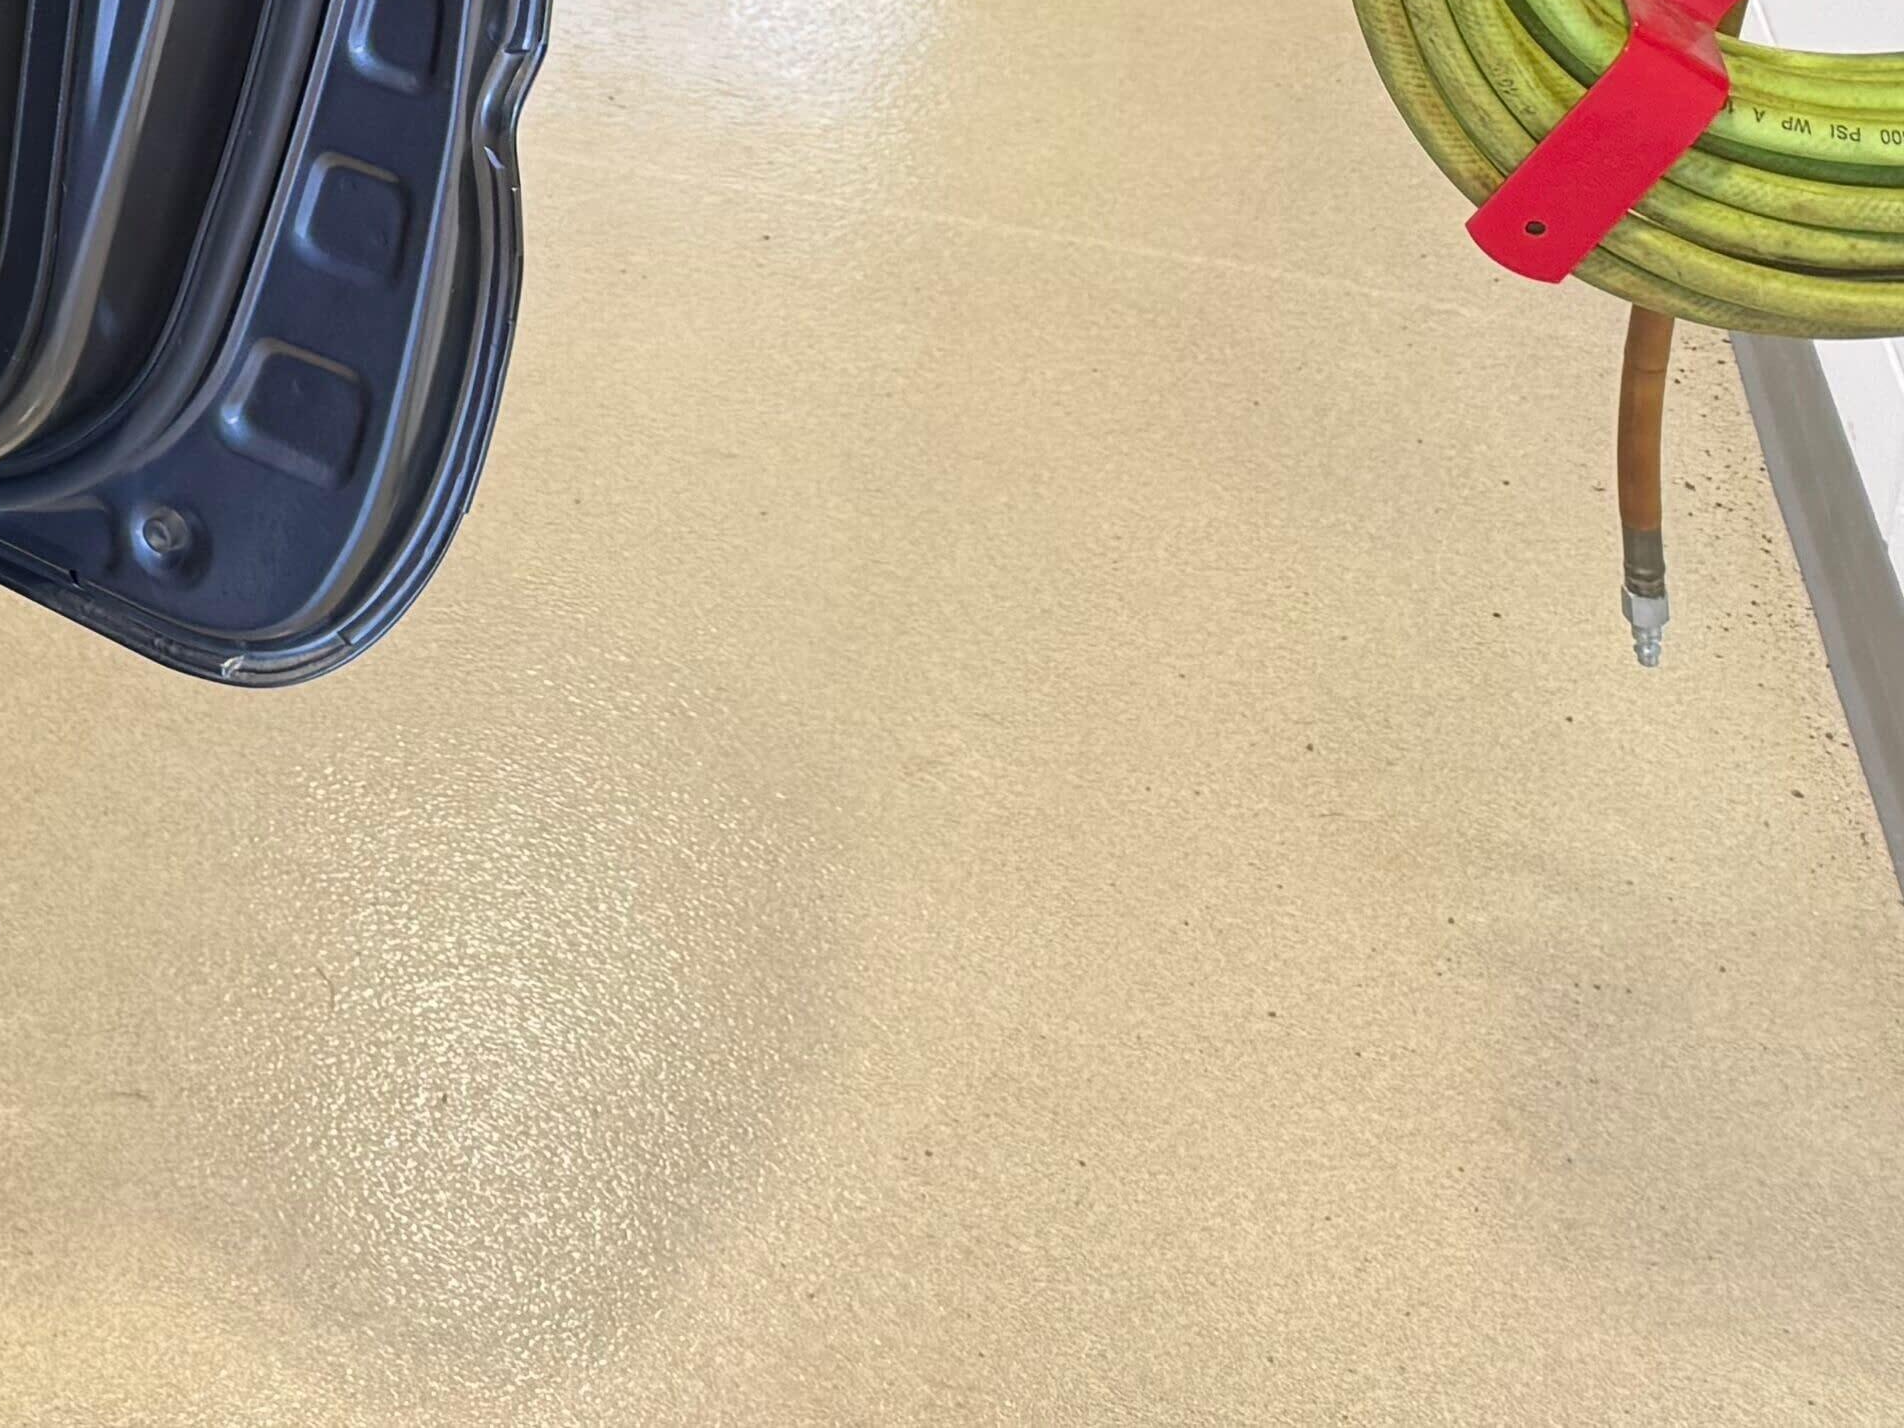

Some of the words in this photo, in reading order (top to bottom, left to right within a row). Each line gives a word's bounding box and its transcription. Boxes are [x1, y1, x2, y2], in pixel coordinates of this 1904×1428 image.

[1752, 106, 1766, 123] A
[1781, 116, 1812, 136] WP
[1830, 123, 1861, 142] PSI
